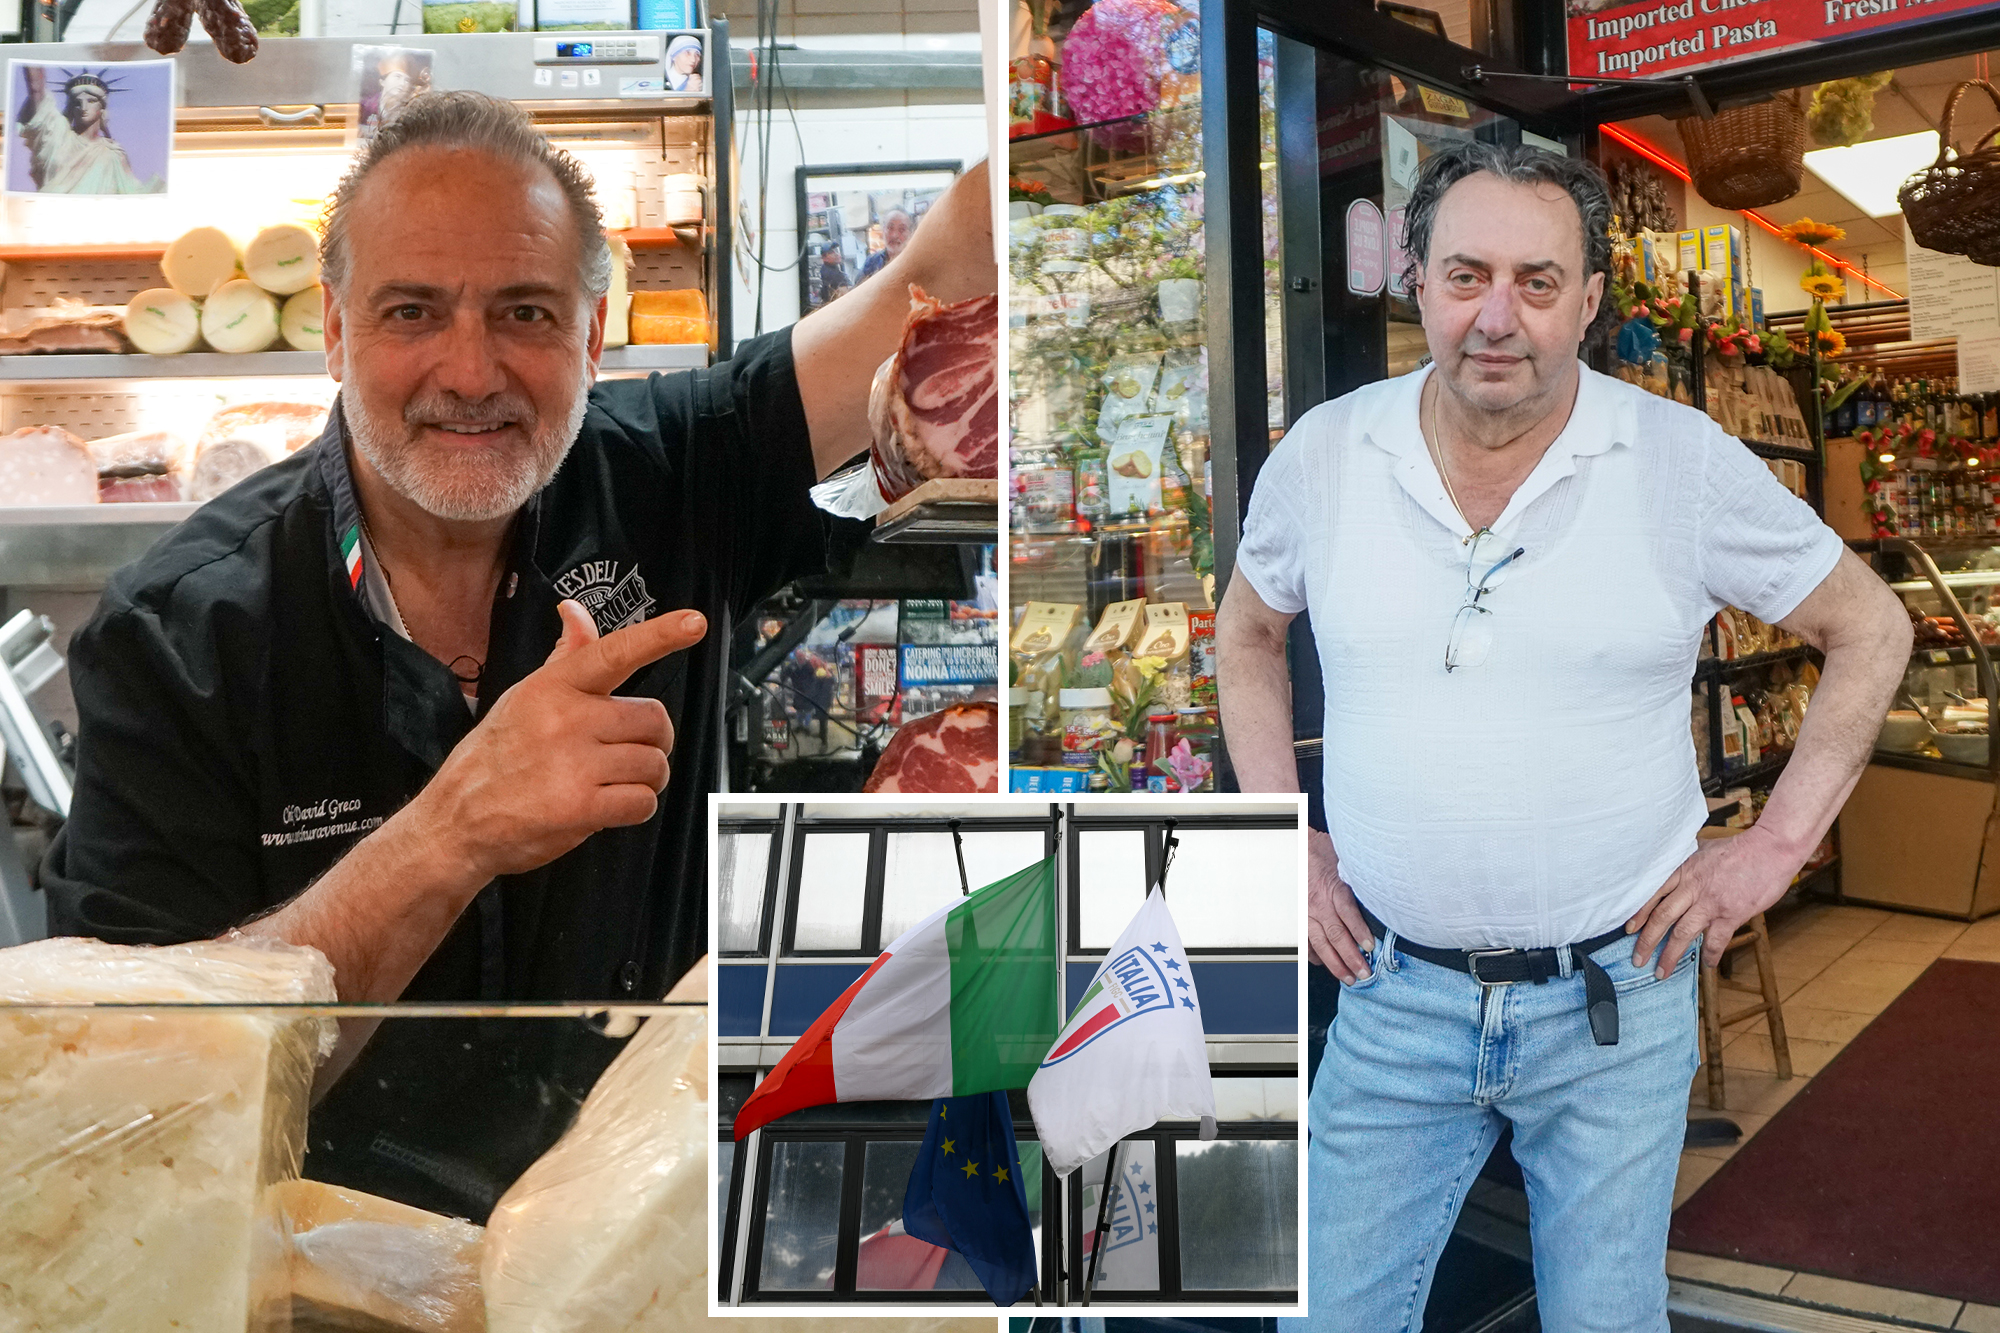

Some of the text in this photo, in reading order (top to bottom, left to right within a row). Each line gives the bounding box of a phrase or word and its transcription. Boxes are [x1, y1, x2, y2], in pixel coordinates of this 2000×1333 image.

[1587, 0, 1695, 41] Imported
[1824, 0, 1899, 25] Fresh
[1597, 18, 1778, 73] Imported Pasta
[581, 560, 619, 586] DELI
[905, 647, 941, 659] CATERING
[953, 646, 997, 659] INCREDIBLE
[905, 664, 949, 680] NONNA
[294, 799, 328, 822] David
[328, 799, 361, 819] Greco
[1107, 982, 1124, 999] FIGC
[1111, 953, 1161, 1010] ITALIA
